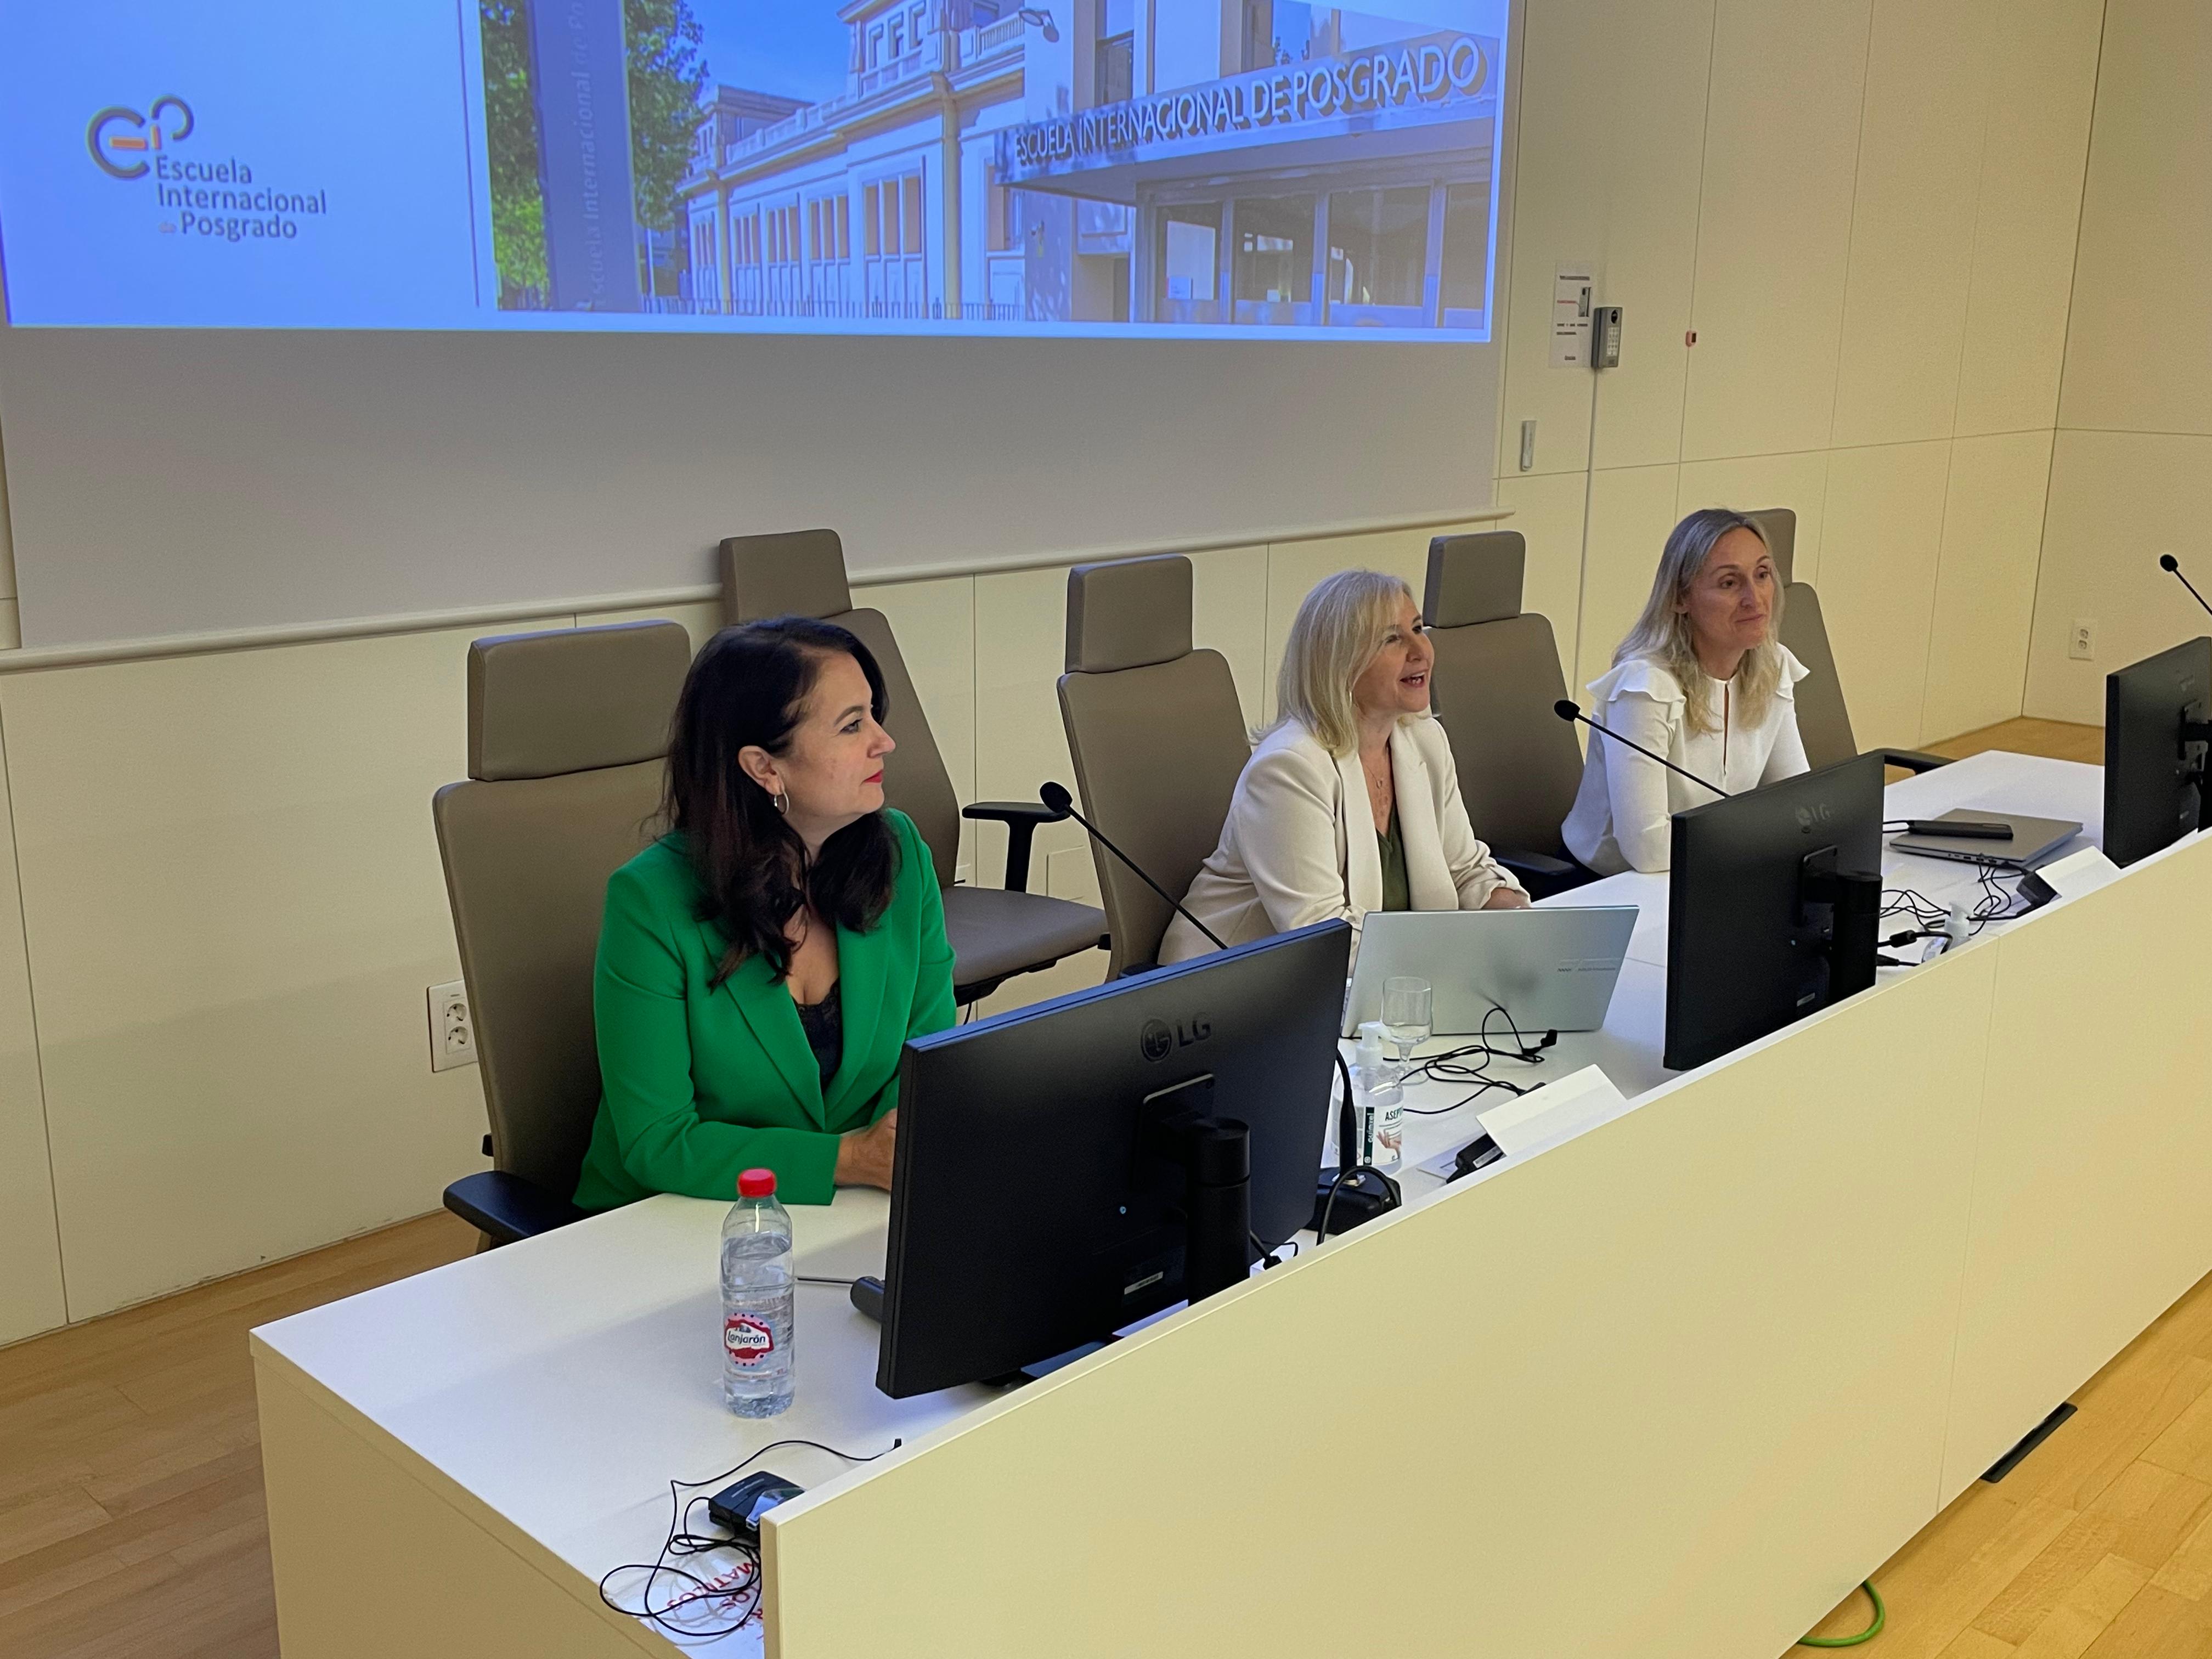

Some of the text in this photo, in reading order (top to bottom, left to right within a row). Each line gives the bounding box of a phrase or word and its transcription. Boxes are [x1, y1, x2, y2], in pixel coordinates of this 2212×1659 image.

[1015, 36, 1480, 160] ESCUELA INTERNACIONAL DE POSGRADO
[571, 72, 599, 219] Internacional
[155, 156, 252, 183] Escuela
[157, 184, 326, 214] Internacional
[180, 211, 297, 242] Posgrado
[1177, 1013, 1212, 1047] LG
[727, 1331, 766, 1344] Lanjarón
